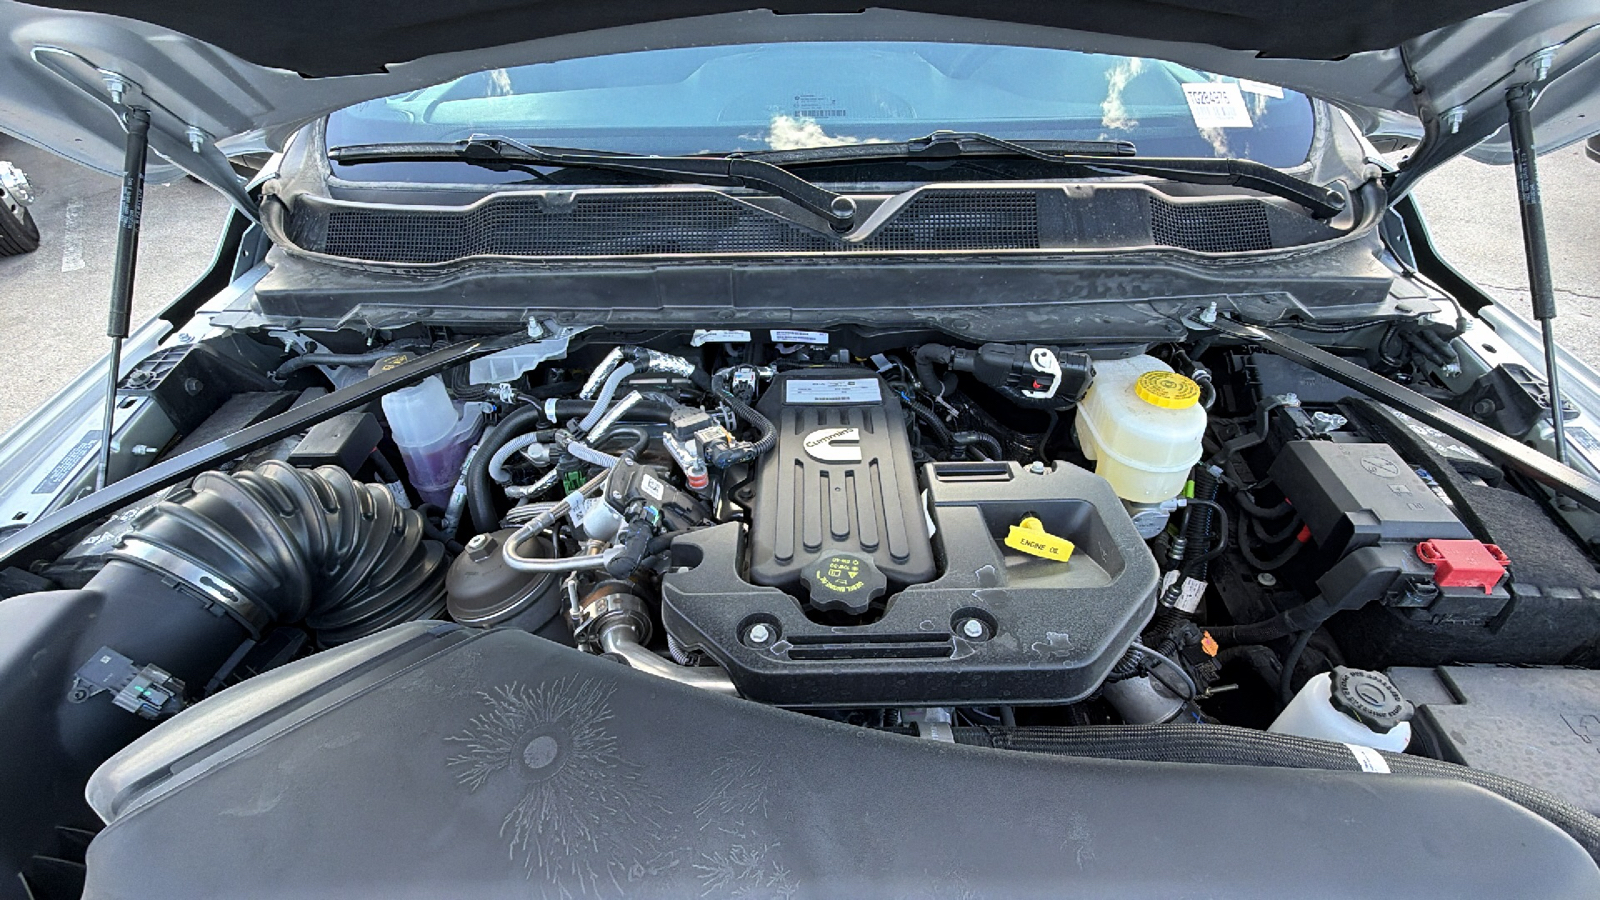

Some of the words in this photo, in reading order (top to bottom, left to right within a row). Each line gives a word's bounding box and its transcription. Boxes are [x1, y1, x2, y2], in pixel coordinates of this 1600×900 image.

[806, 428, 854, 447] Cummins
[1020, 538, 1046, 551] ENGINE
[1049, 547, 1059, 555] OIL
